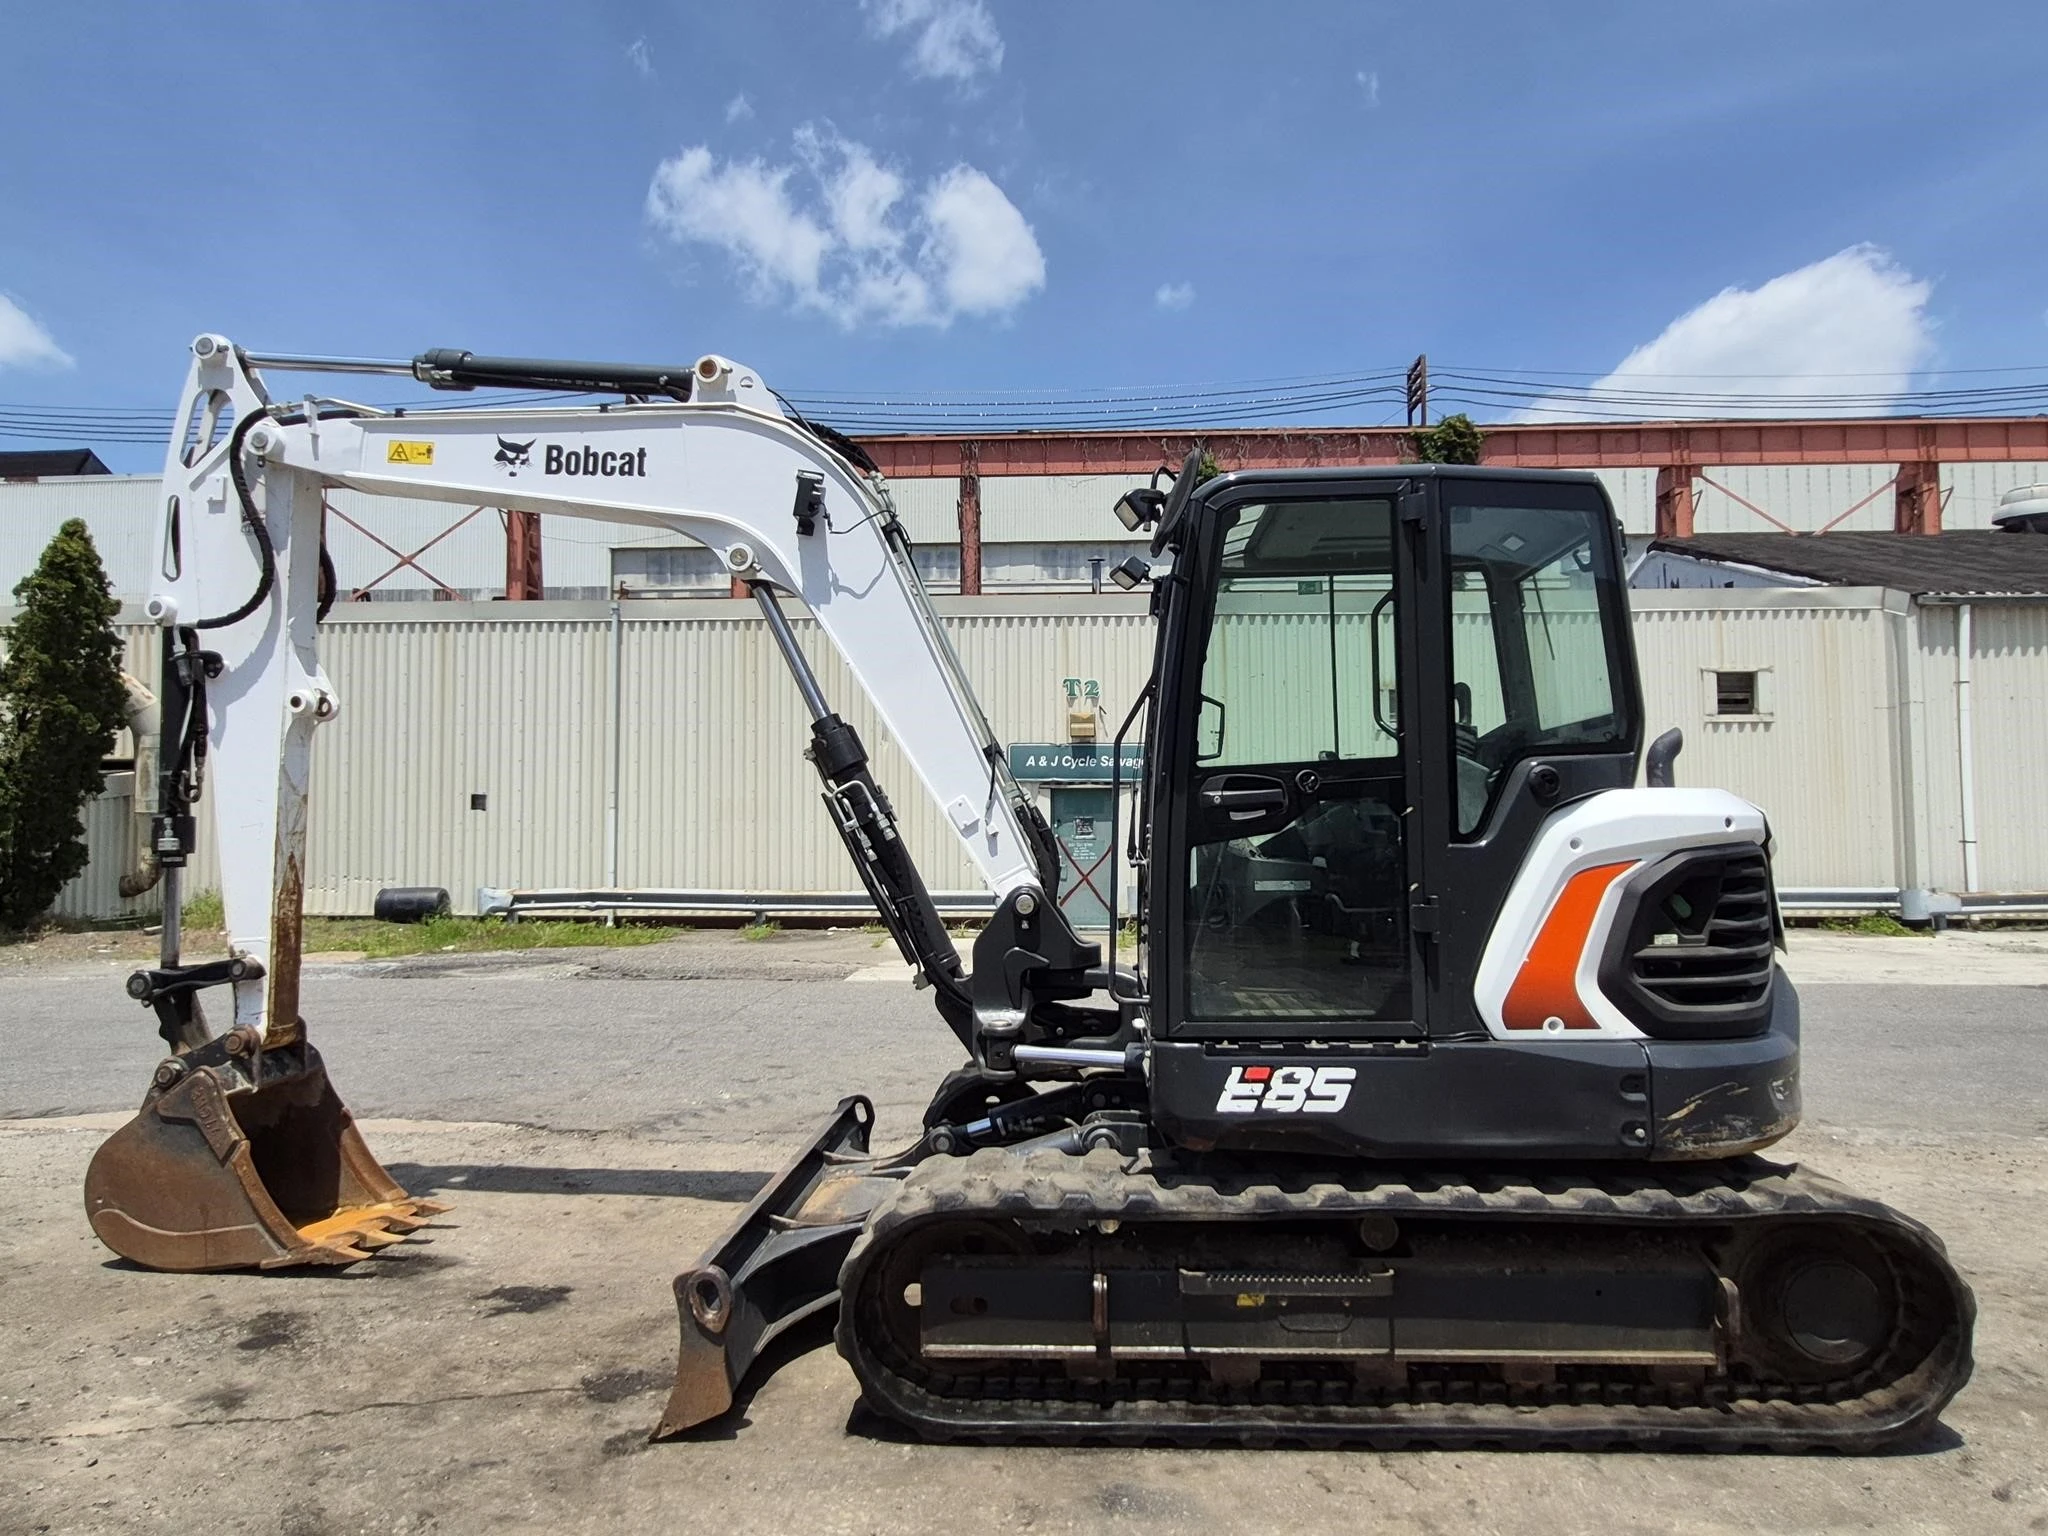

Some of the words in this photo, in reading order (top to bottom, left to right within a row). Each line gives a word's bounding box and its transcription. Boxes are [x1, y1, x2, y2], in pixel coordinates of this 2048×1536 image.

[545, 444, 647, 477] Bobcat
[1063, 678, 1100, 698] T2
[1025, 755, 1036, 767] A
[1038, 755, 1048, 767] &
[1050, 755, 1059, 767] J
[1061, 755, 1097, 770] Cycle
[1100, 755, 1144, 769] Savag
[1216, 1066, 1357, 1112] E85
